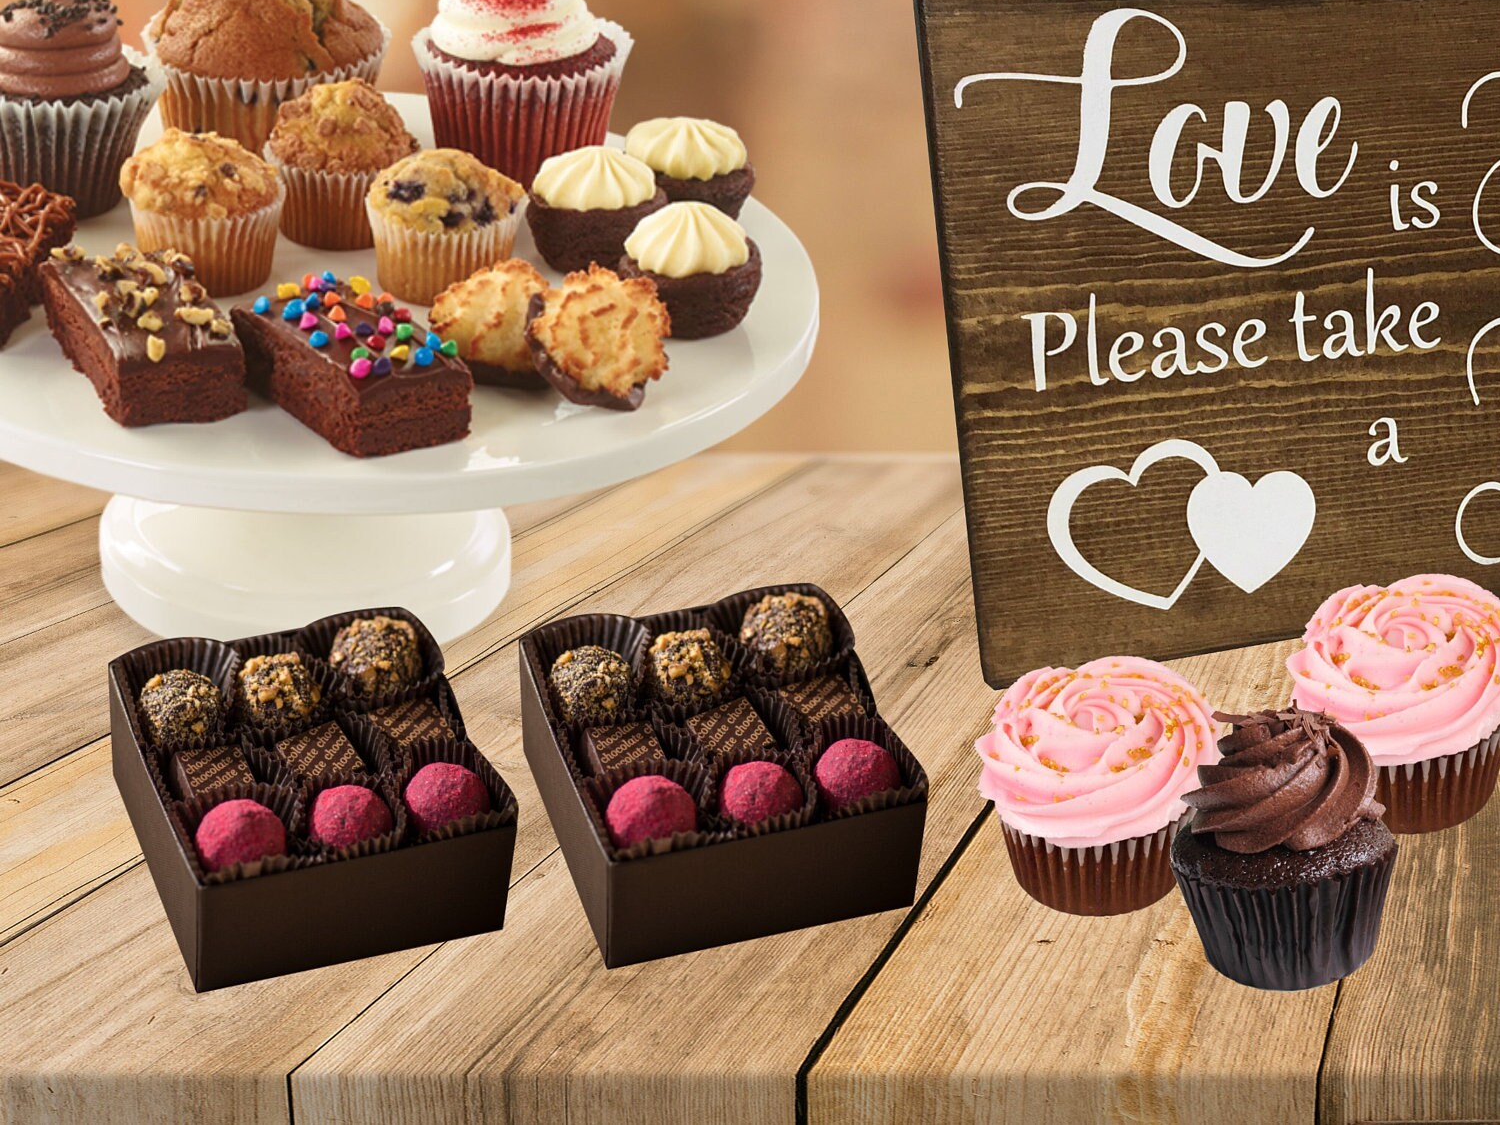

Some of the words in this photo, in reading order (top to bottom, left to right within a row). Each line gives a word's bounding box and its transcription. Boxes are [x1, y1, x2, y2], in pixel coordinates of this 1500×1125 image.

[953, 7, 1359, 268] Love
[1387, 159, 1441, 231] is
[1020, 291, 1269, 393] Please
[1295, 267, 1442, 360] take
[1367, 417, 1409, 467] a
[190, 757, 233, 787] chocolate
[600, 733, 644, 764] chocolate
